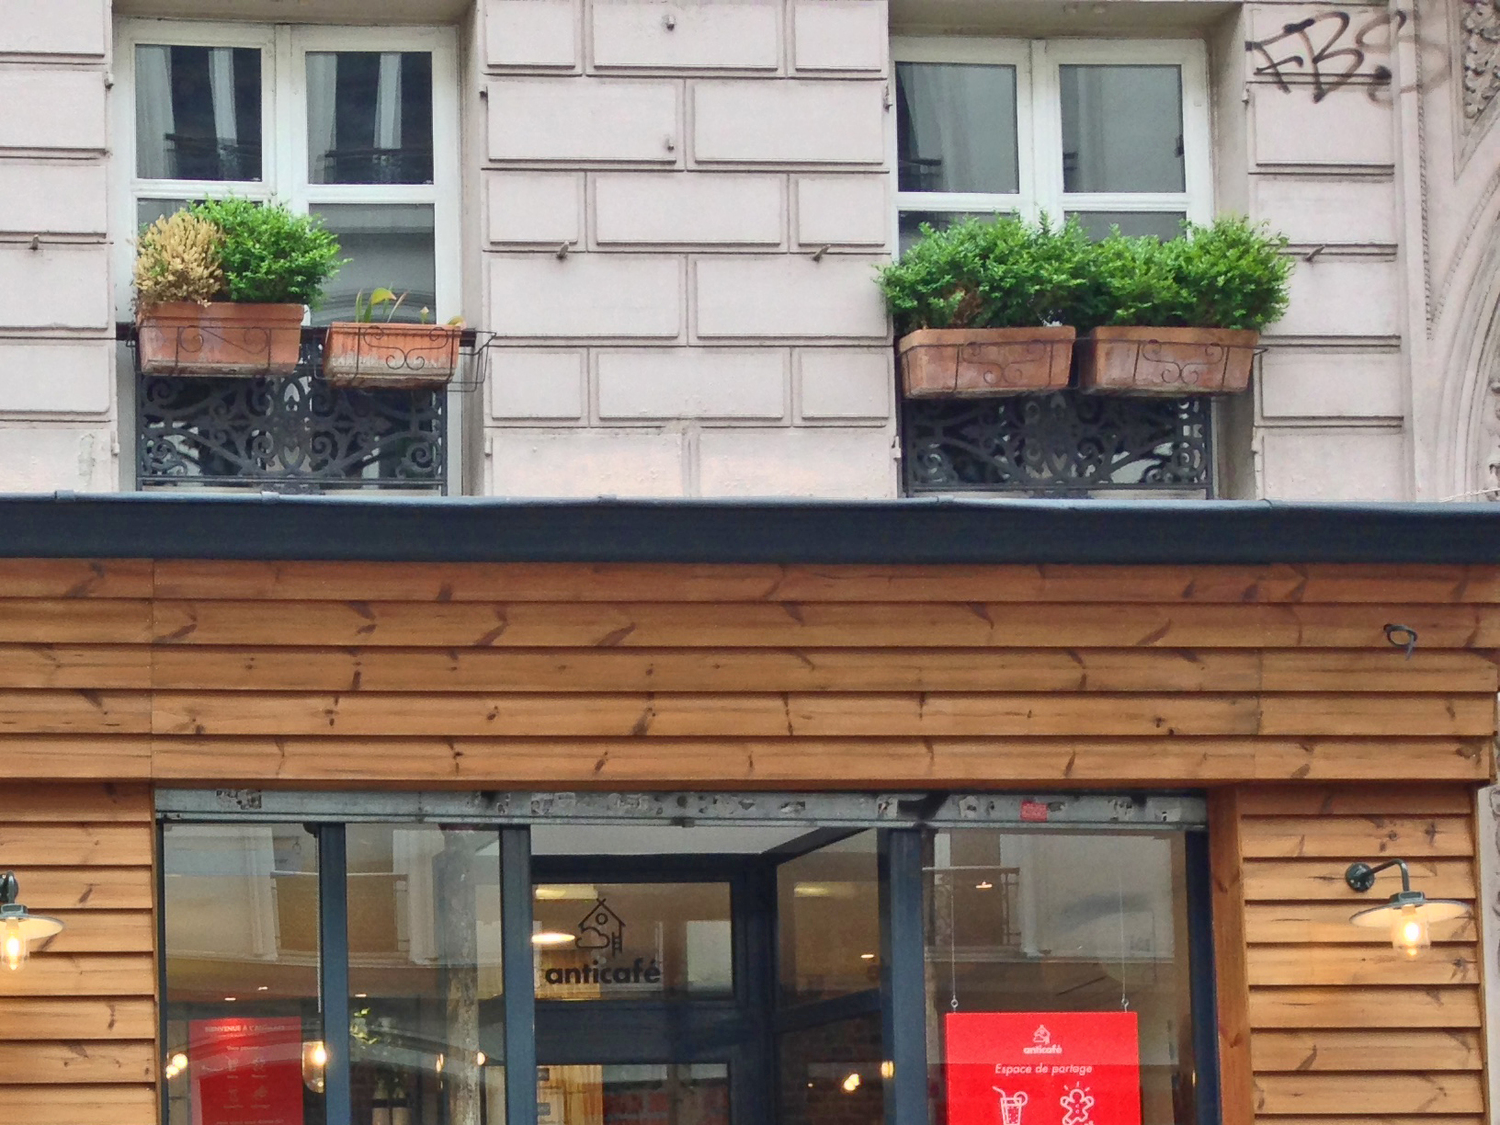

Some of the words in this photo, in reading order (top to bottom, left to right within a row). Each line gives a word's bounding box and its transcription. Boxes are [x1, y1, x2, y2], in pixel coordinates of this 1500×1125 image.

[545, 958, 661, 984] anticafé
[1023, 1043, 1063, 1055] anticafé
[995, 1063, 1032, 1077] Espace
[1035, 1062, 1049, 1075] de
[1051, 1064, 1093, 1077] partage
